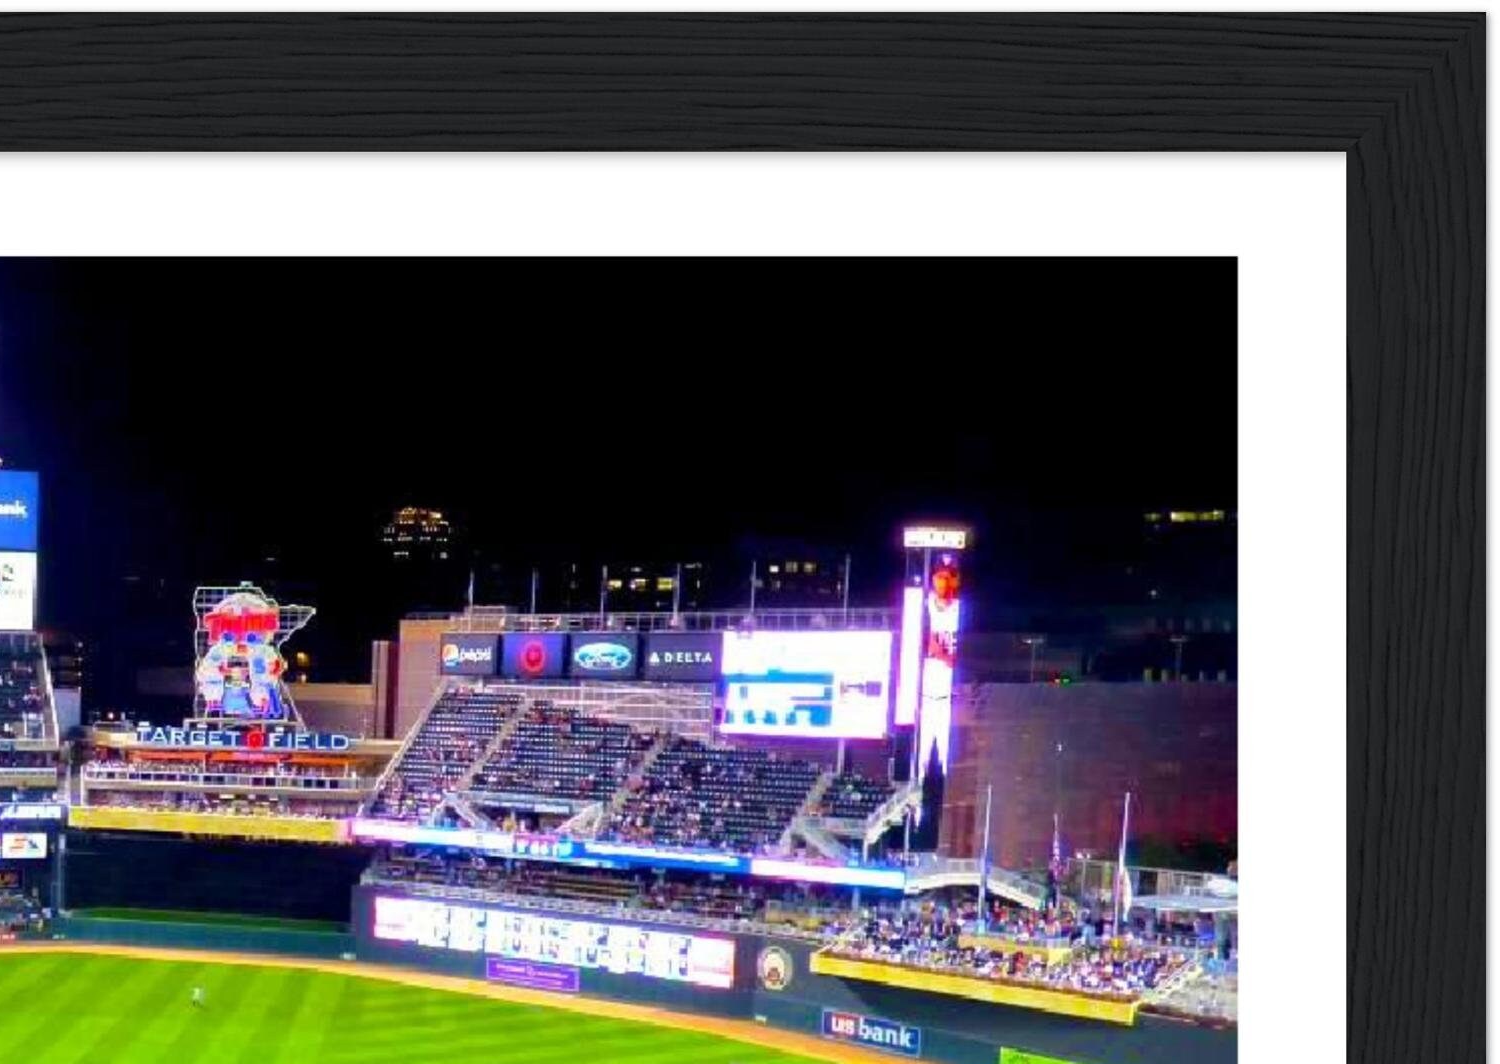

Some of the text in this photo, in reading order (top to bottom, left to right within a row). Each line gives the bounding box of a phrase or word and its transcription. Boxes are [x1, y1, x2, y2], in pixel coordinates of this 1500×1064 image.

[663, 651, 713, 664] DELTA
[136, 726, 349, 750] TARGET FIELD
